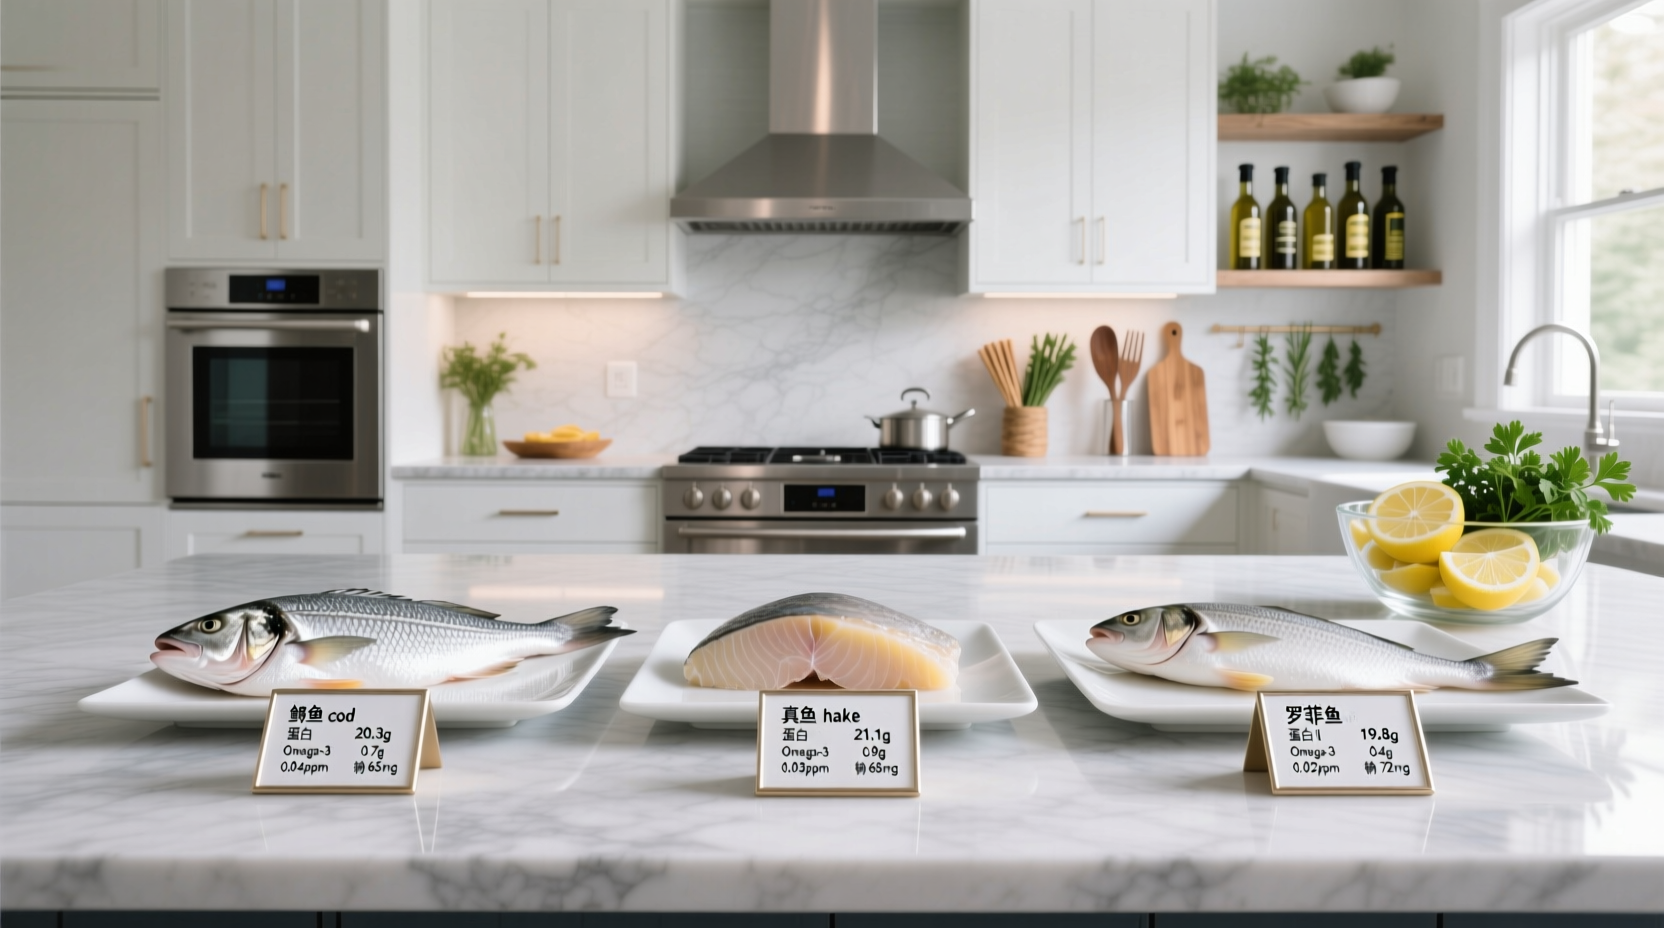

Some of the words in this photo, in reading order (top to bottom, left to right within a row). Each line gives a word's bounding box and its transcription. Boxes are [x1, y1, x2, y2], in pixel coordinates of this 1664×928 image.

[327, 707, 356, 723] cod
[823, 707, 861, 724] hake
[354, 726, 392, 744] 20.3g
[853, 727, 891, 745] 21.1g
[1360, 727, 1399, 744] 19.8g
[280, 760, 329, 776] 0.04ppm
[781, 761, 830, 777] 0.03ppm
[1292, 760, 1340, 776] 0.02ppm
